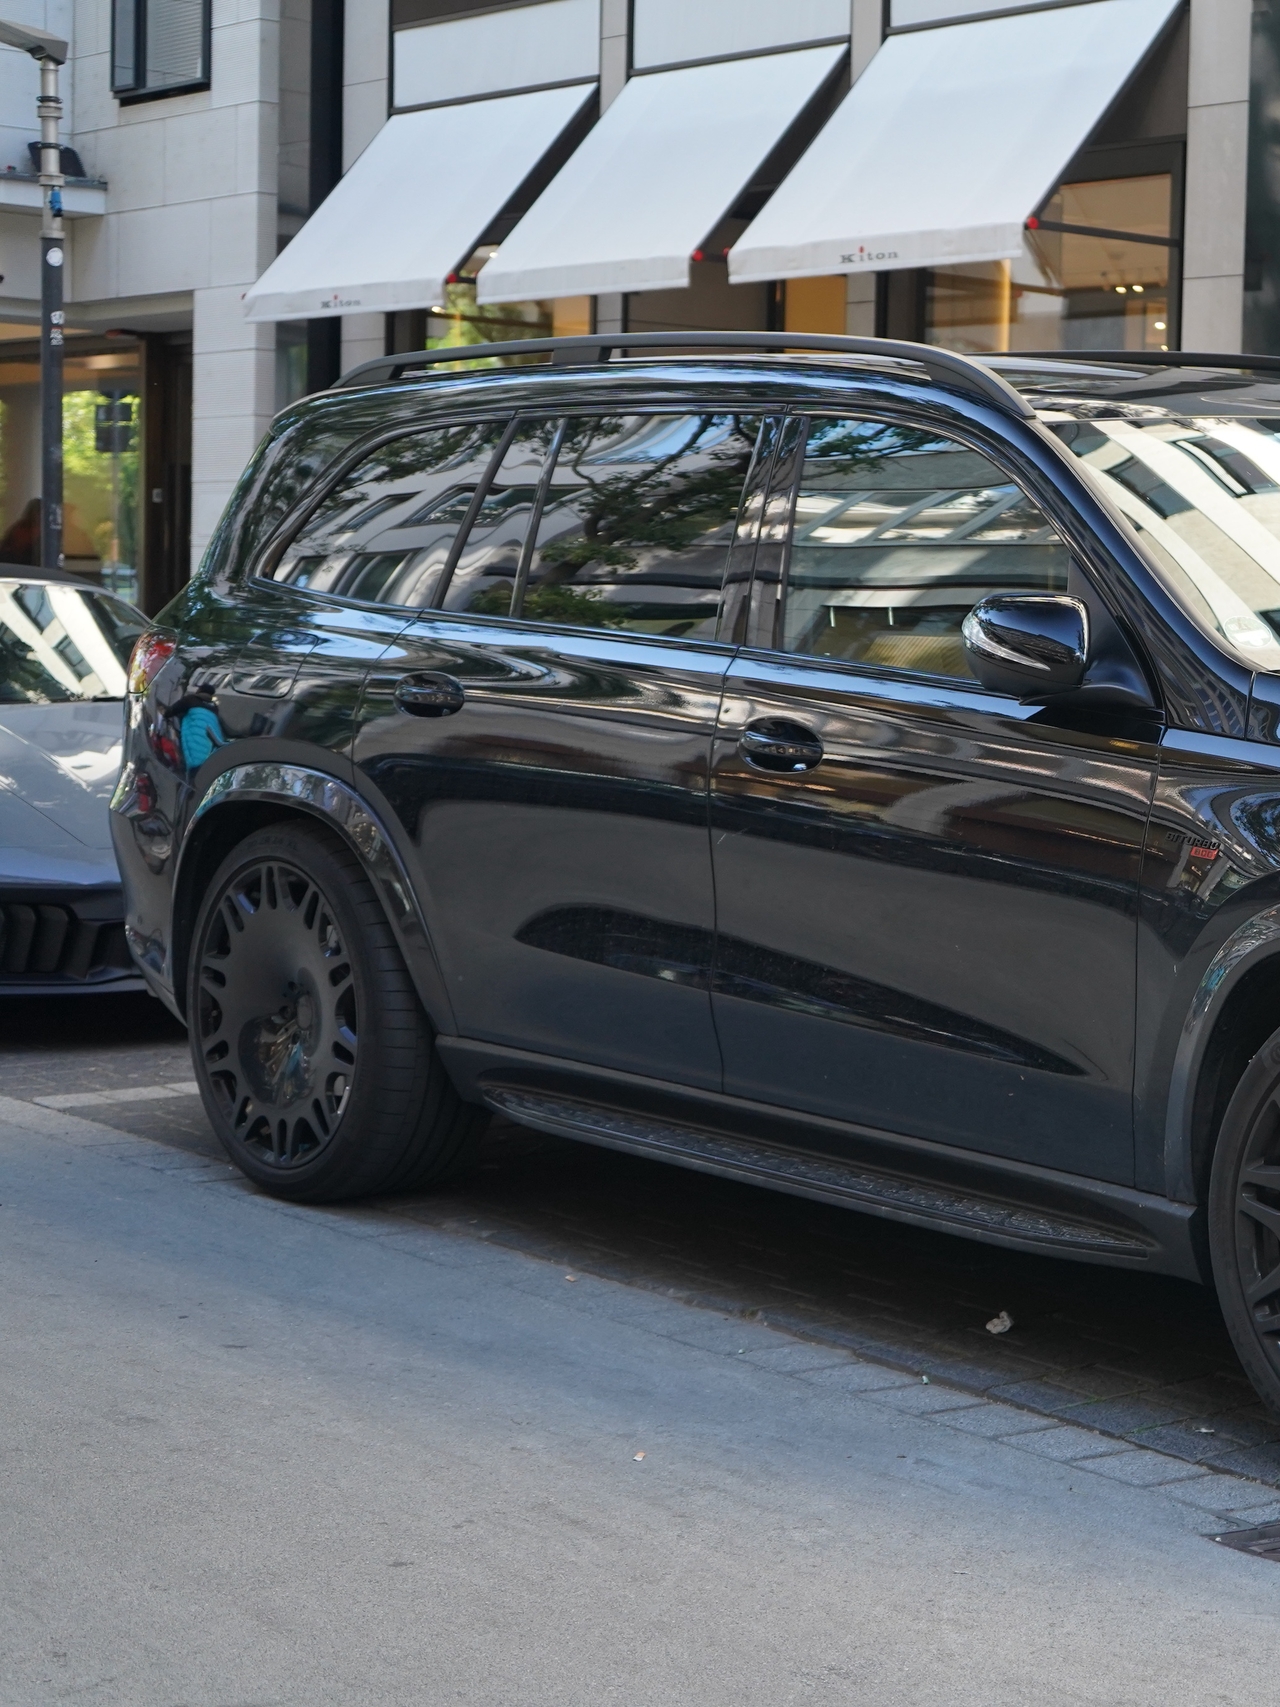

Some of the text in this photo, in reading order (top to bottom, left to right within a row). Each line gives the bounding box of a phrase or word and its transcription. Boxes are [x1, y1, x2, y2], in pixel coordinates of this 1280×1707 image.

[839, 245, 898, 263] Kiton
[1165, 831, 1221, 850] BITURBO
[1194, 848, 1214, 859] 800
